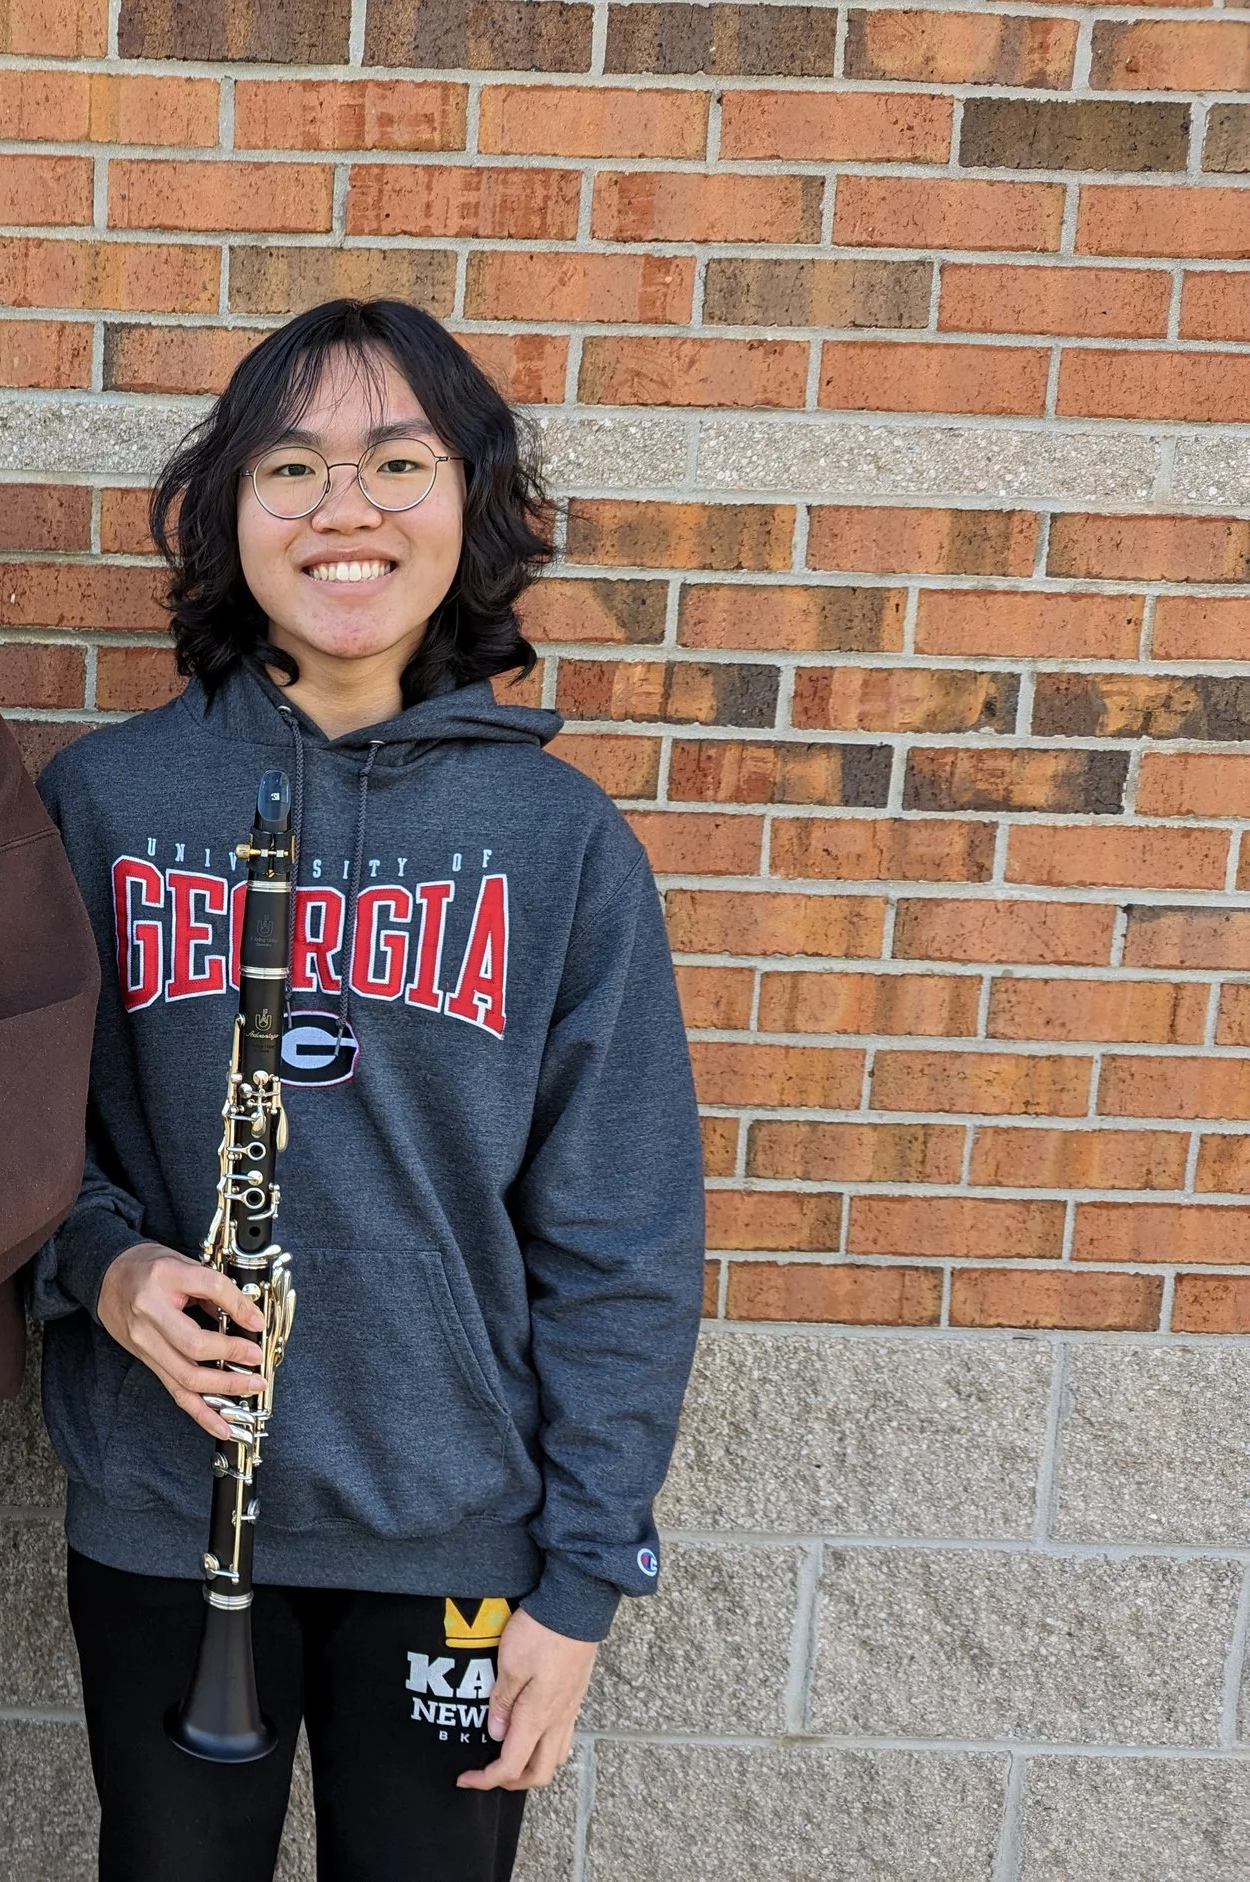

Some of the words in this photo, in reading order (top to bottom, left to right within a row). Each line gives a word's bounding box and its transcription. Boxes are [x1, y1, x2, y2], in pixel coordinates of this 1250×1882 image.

[147, 838, 407, 879] UNIVSITY
[452, 849, 492, 872] OF
[111, 855, 510, 1040] GERGIA
